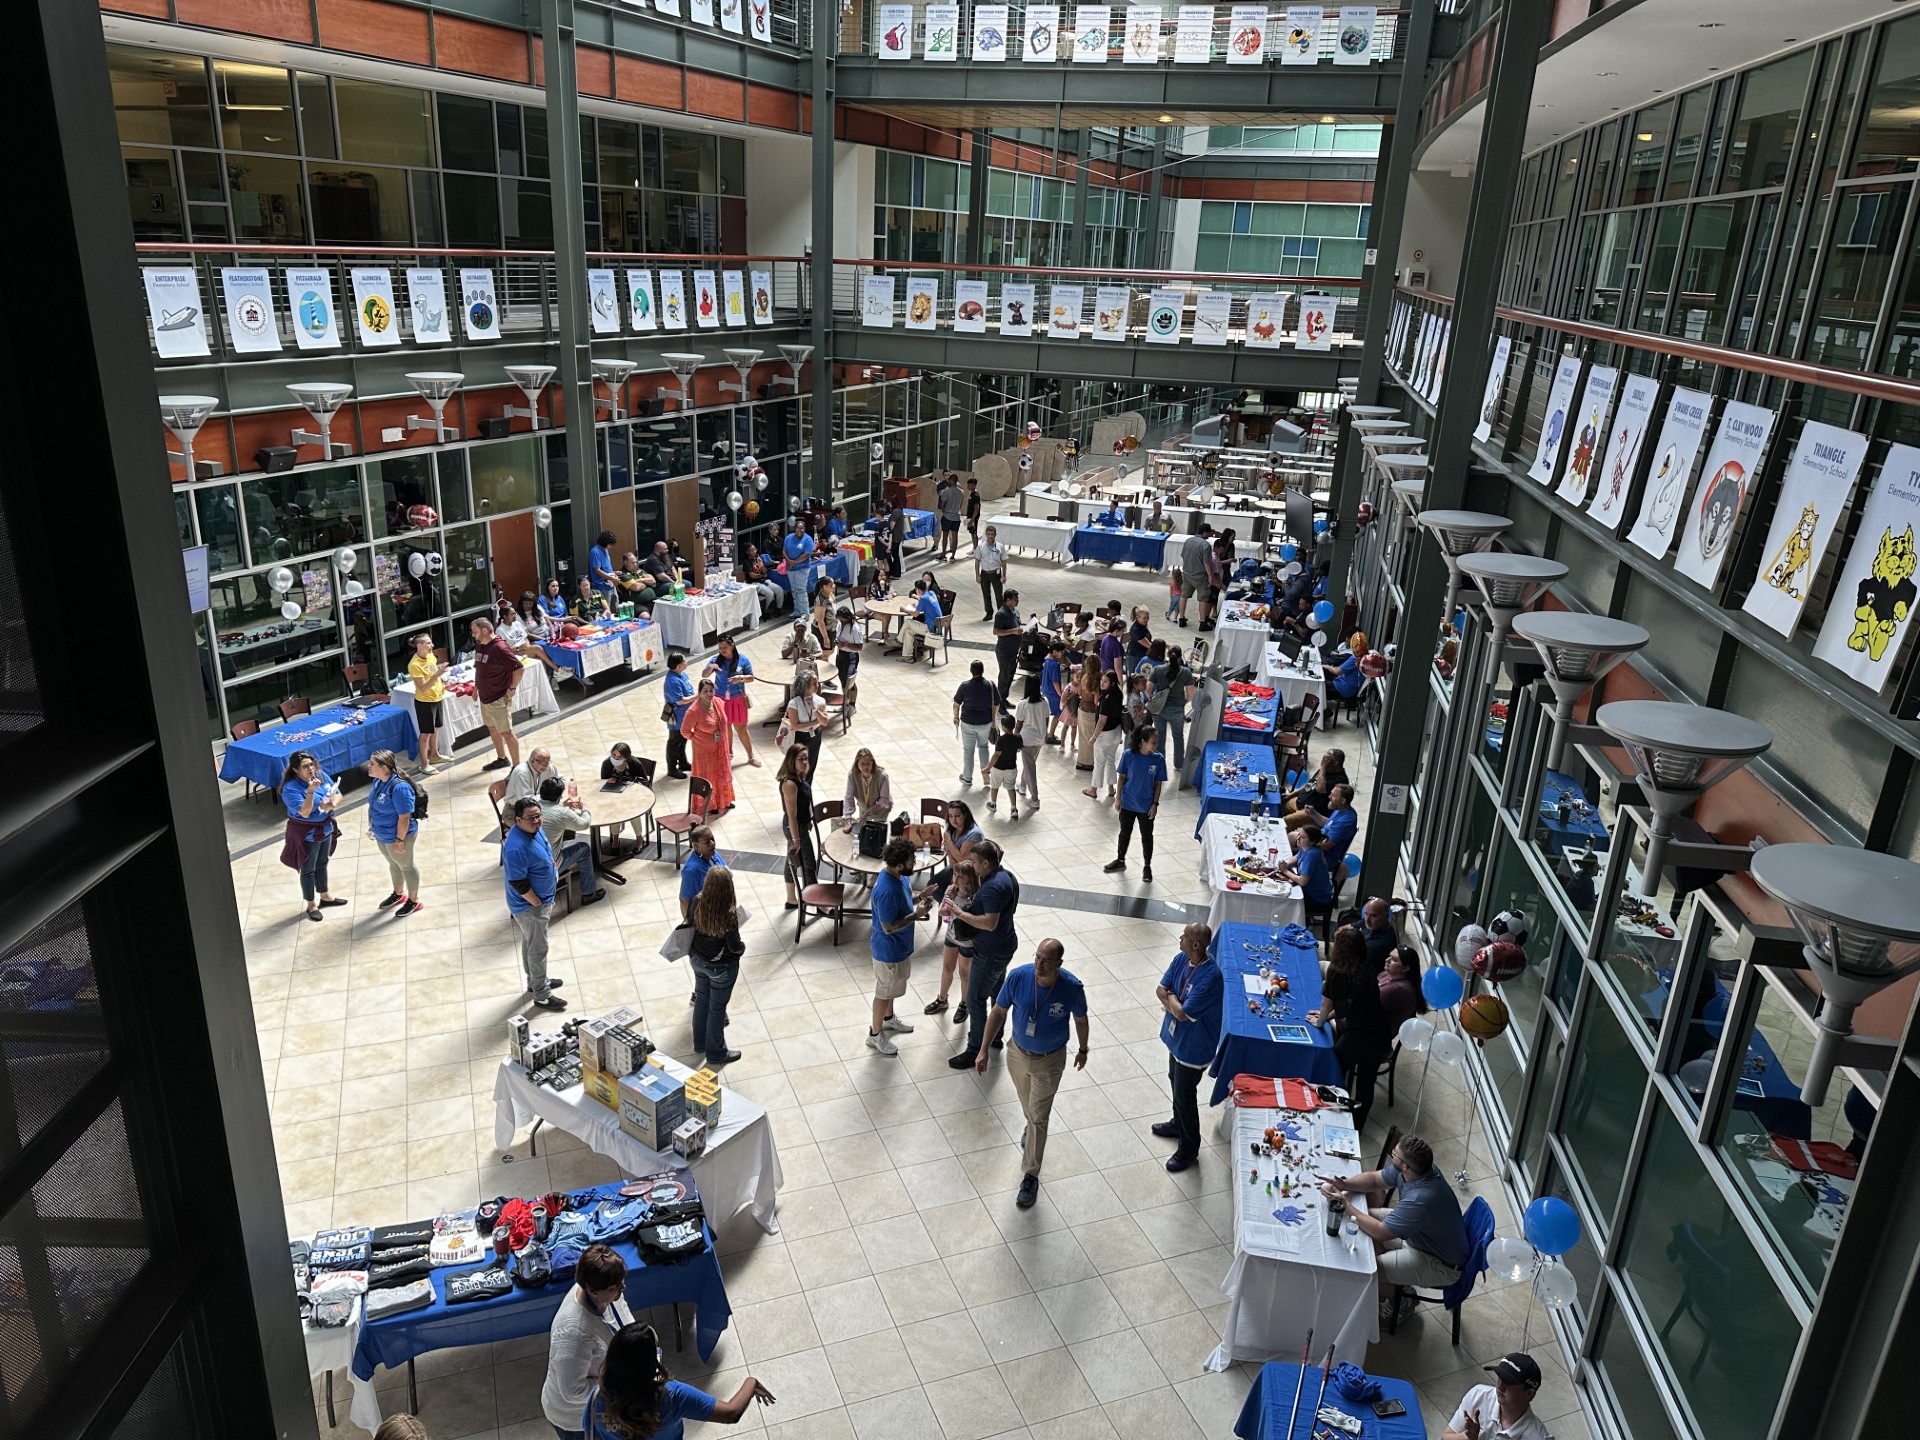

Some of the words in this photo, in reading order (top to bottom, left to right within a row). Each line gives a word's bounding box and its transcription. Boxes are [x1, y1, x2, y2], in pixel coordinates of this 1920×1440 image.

[1674, 401, 1690, 415] SWANS
[1689, 406, 1703, 420] CREEK
[1727, 417, 1732, 429] T.
[1732, 419, 1744, 433] CLAY
[1744, 423, 1763, 439] WOOD
[1724, 430, 1744, 447] Elementary
[1744, 437, 1760, 450] School
[1813, 442, 1846, 465] TRIANGLE
[1803, 455, 1828, 475] Elementary
[1829, 464, 1849, 480] School
[1887, 482, 1920, 507] Elementary
[317, 1230, 369, 1244] LIONS
[332, 1251, 366, 1263] GRAHAM
[431, 1252, 458, 1261] BRAXTON
[460, 1245, 478, 1259] UNITY
[453, 1281, 481, 1295] RIDGE
[483, 1274, 508, 1288] LAKE
